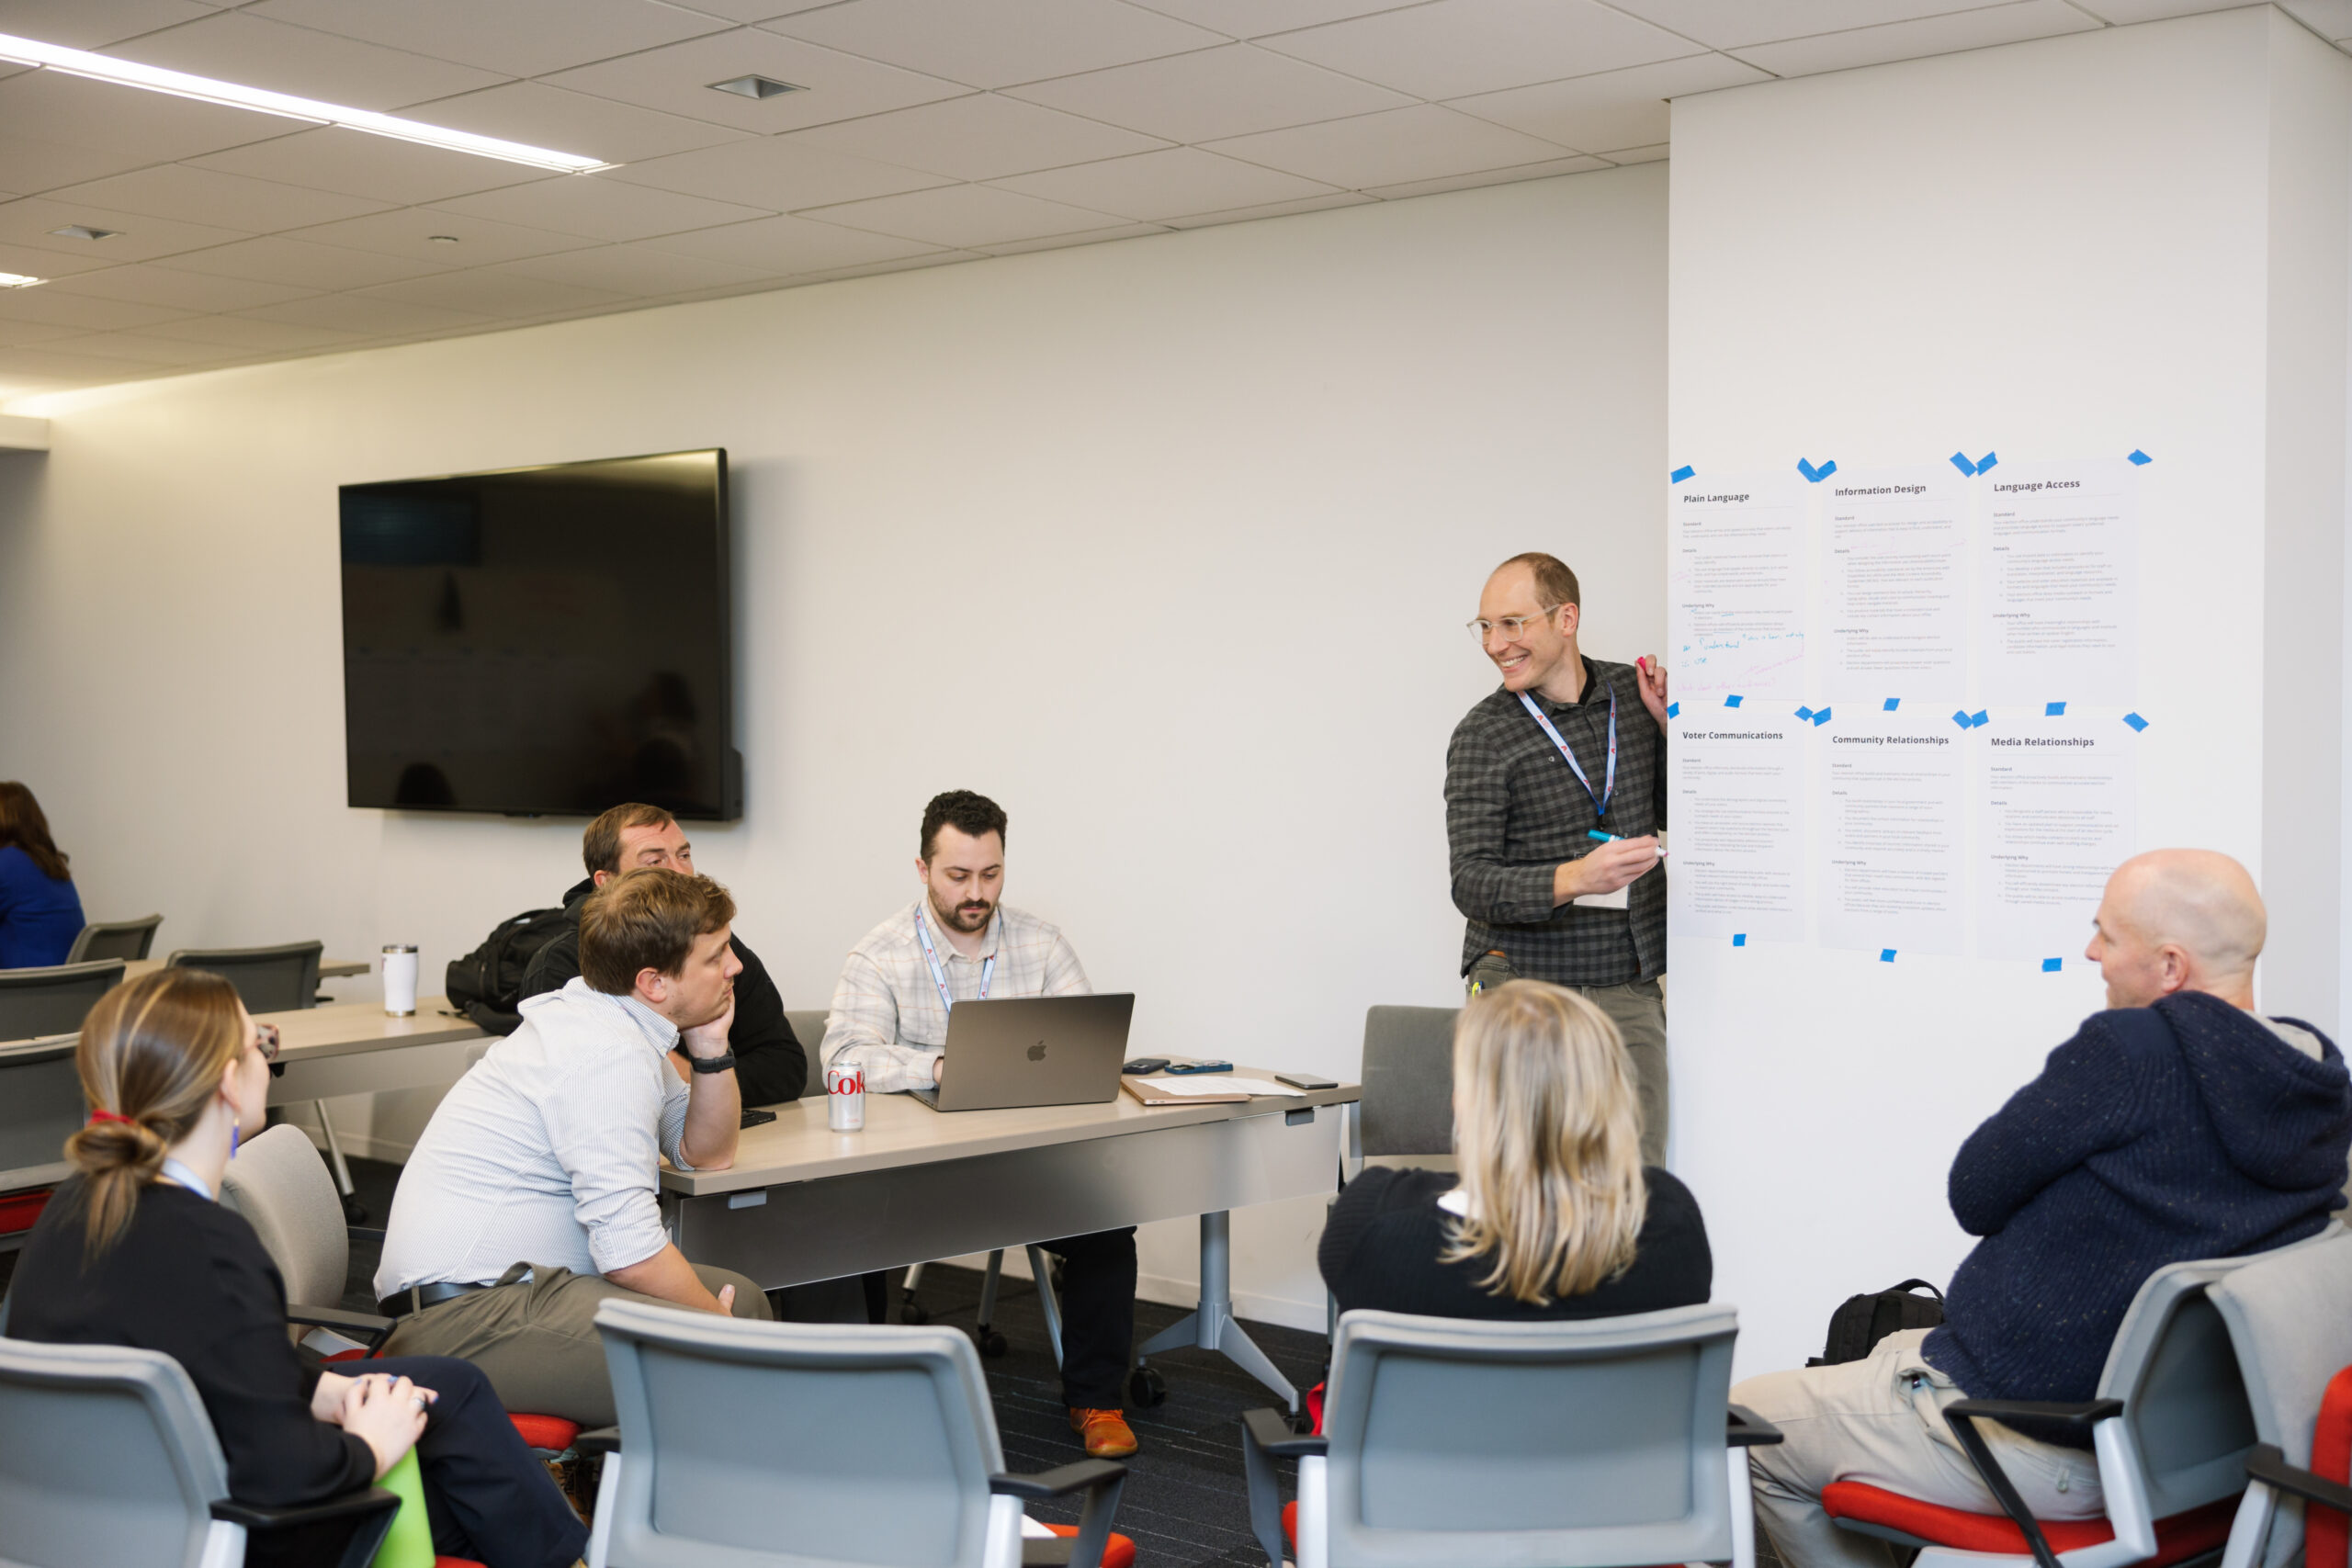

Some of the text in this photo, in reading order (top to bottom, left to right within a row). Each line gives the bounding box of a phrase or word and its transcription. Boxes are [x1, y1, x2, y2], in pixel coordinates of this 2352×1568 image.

[1835, 484, 1927, 497] Information Design
[1994, 479, 2081, 493] Language Access
[1683, 492, 1749, 503] Plain Language
[1682, 731, 1783, 739] Voter Communications
[1832, 736, 1950, 746] Community Relationships
[1991, 737, 2095, 748] Media Relationships
